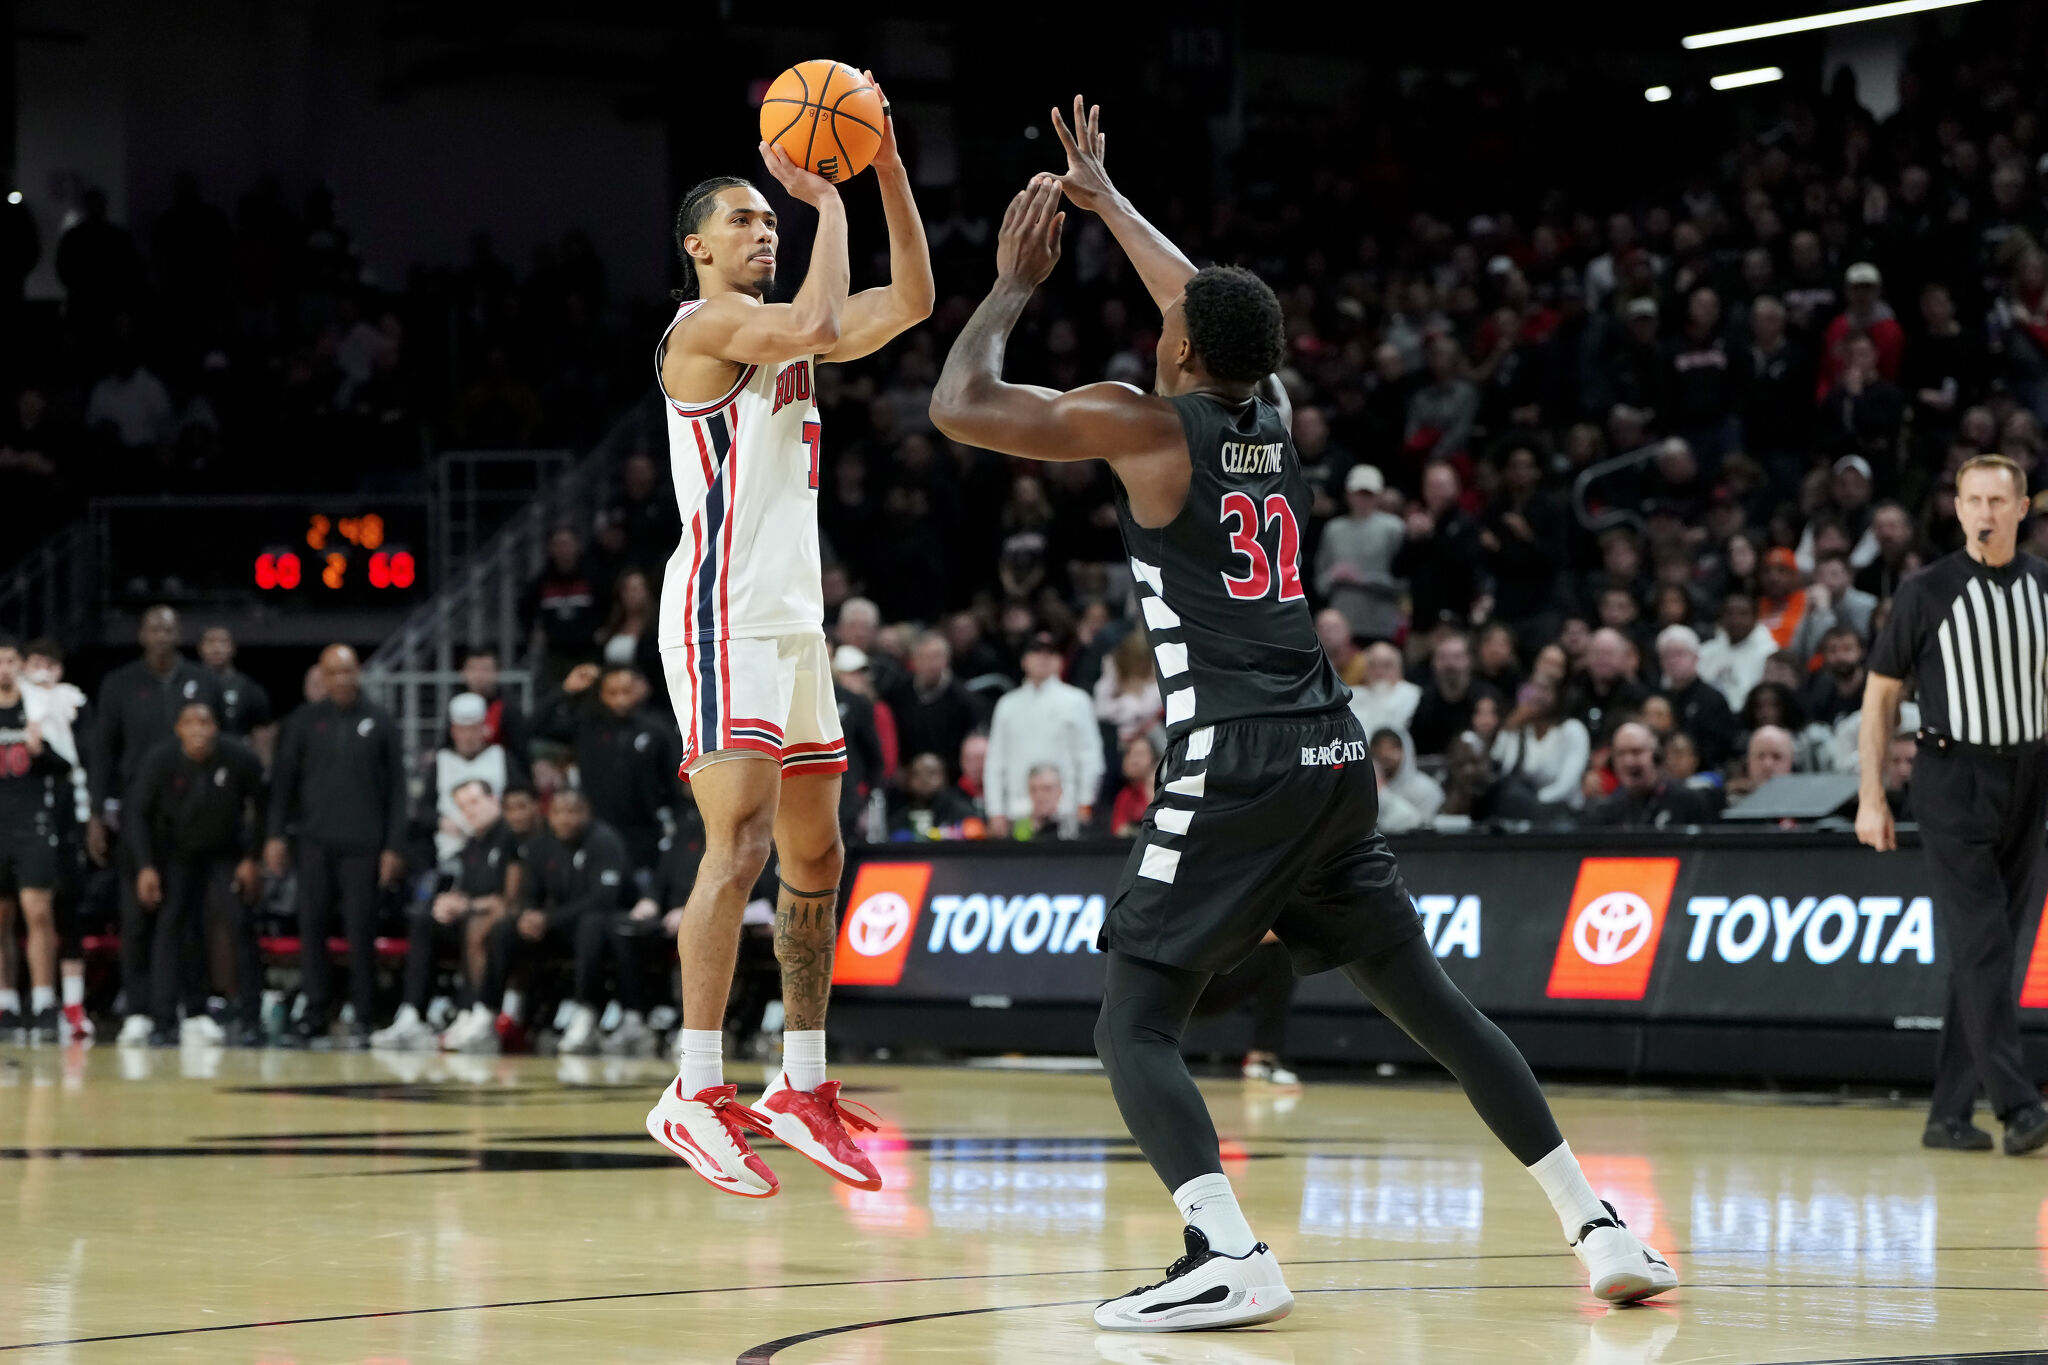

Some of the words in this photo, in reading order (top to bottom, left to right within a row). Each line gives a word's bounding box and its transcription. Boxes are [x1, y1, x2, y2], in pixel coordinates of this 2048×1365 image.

[771, 360, 817, 416] HOU
[1221, 441, 1284, 474] CELESTINE
[1220, 491, 1306, 602] 32
[1300, 739, 1366, 766] BEARCATS
[927, 892, 1106, 955] TOYOTA
[1686, 893, 1936, 965] TOYOTA
